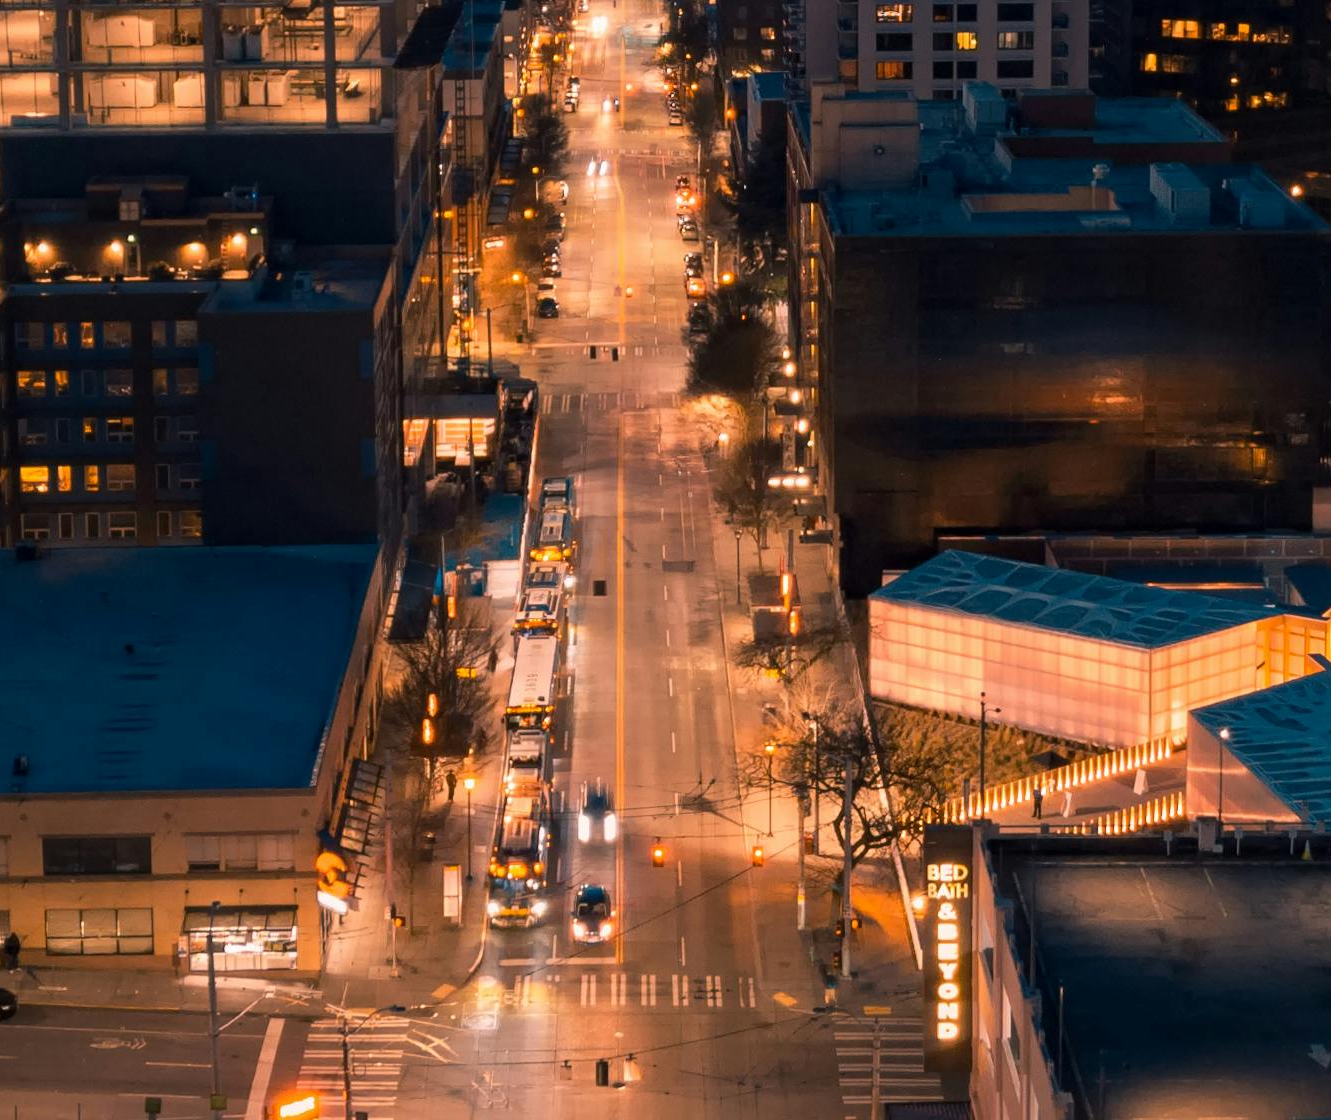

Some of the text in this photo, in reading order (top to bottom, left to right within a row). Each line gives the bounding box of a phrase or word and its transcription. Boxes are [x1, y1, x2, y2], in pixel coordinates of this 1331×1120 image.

[927, 863, 969, 881] BED
[927, 882, 969, 900] BATH
[937, 902, 957, 921] &
[937, 923, 959, 1040] BEYOND
